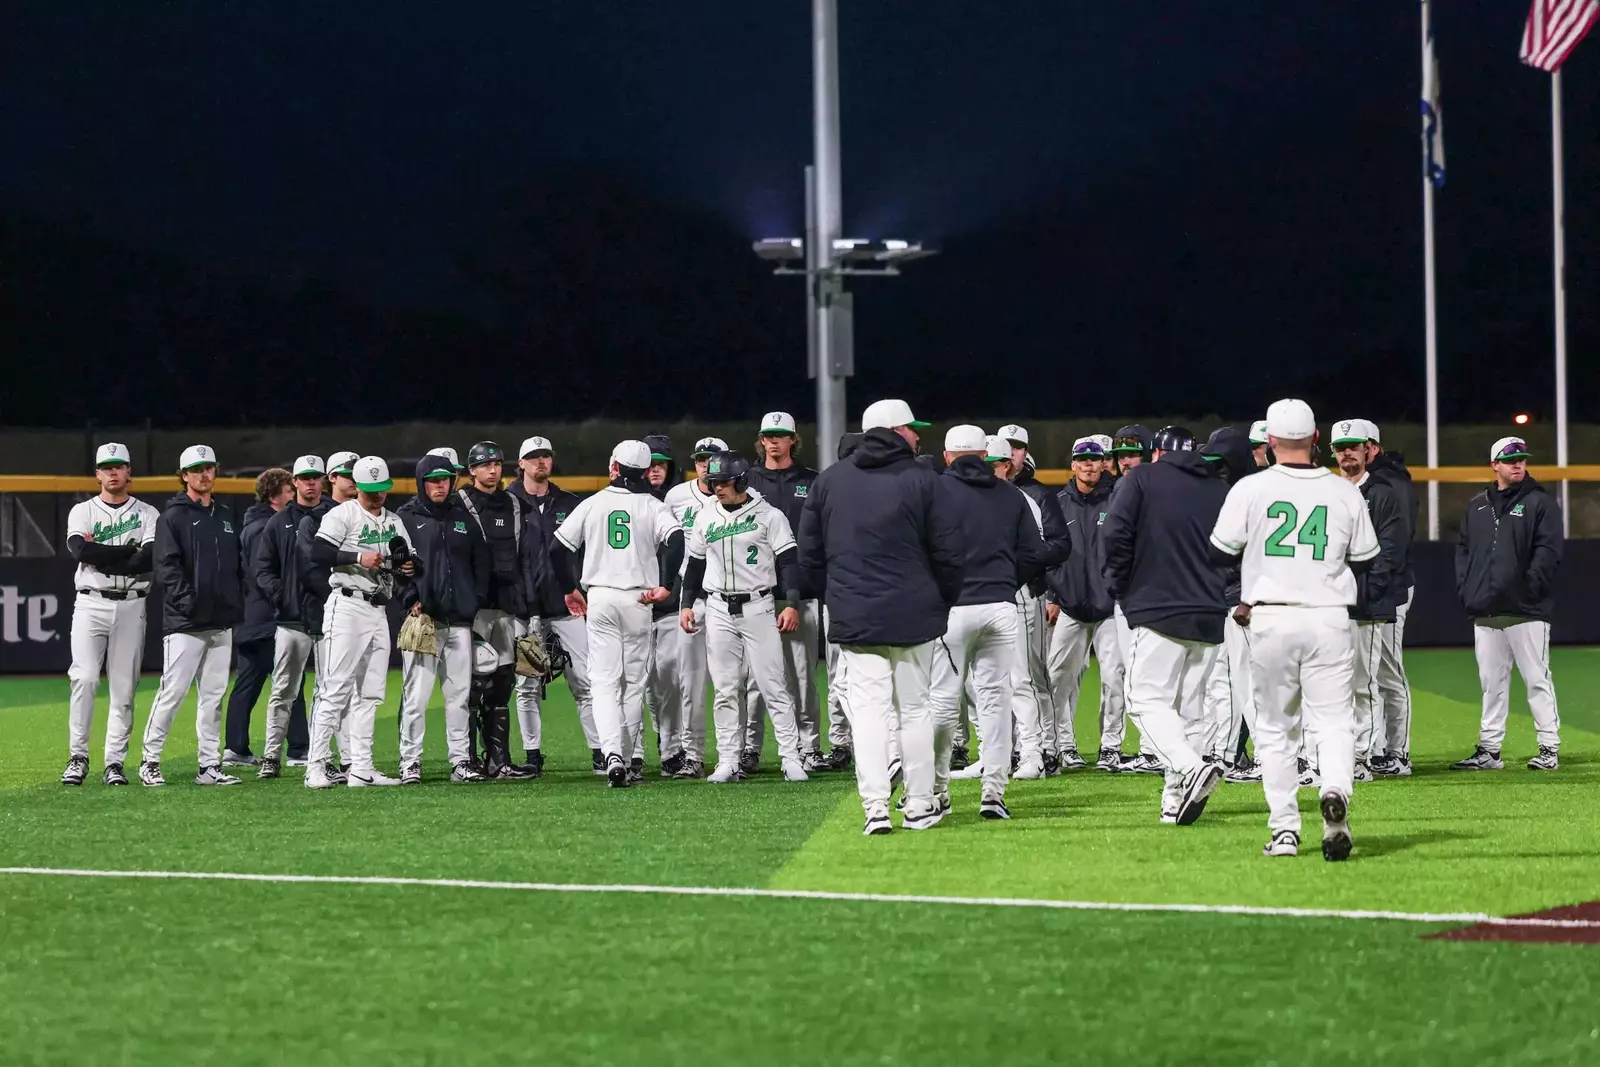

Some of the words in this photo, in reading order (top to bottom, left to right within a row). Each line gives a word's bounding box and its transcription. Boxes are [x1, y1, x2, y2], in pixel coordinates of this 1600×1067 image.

[608, 510, 630, 549] 6
[705, 514, 759, 545] Marshall
[1265, 501, 1328, 561] 24
[746, 545, 758, 564] 2
